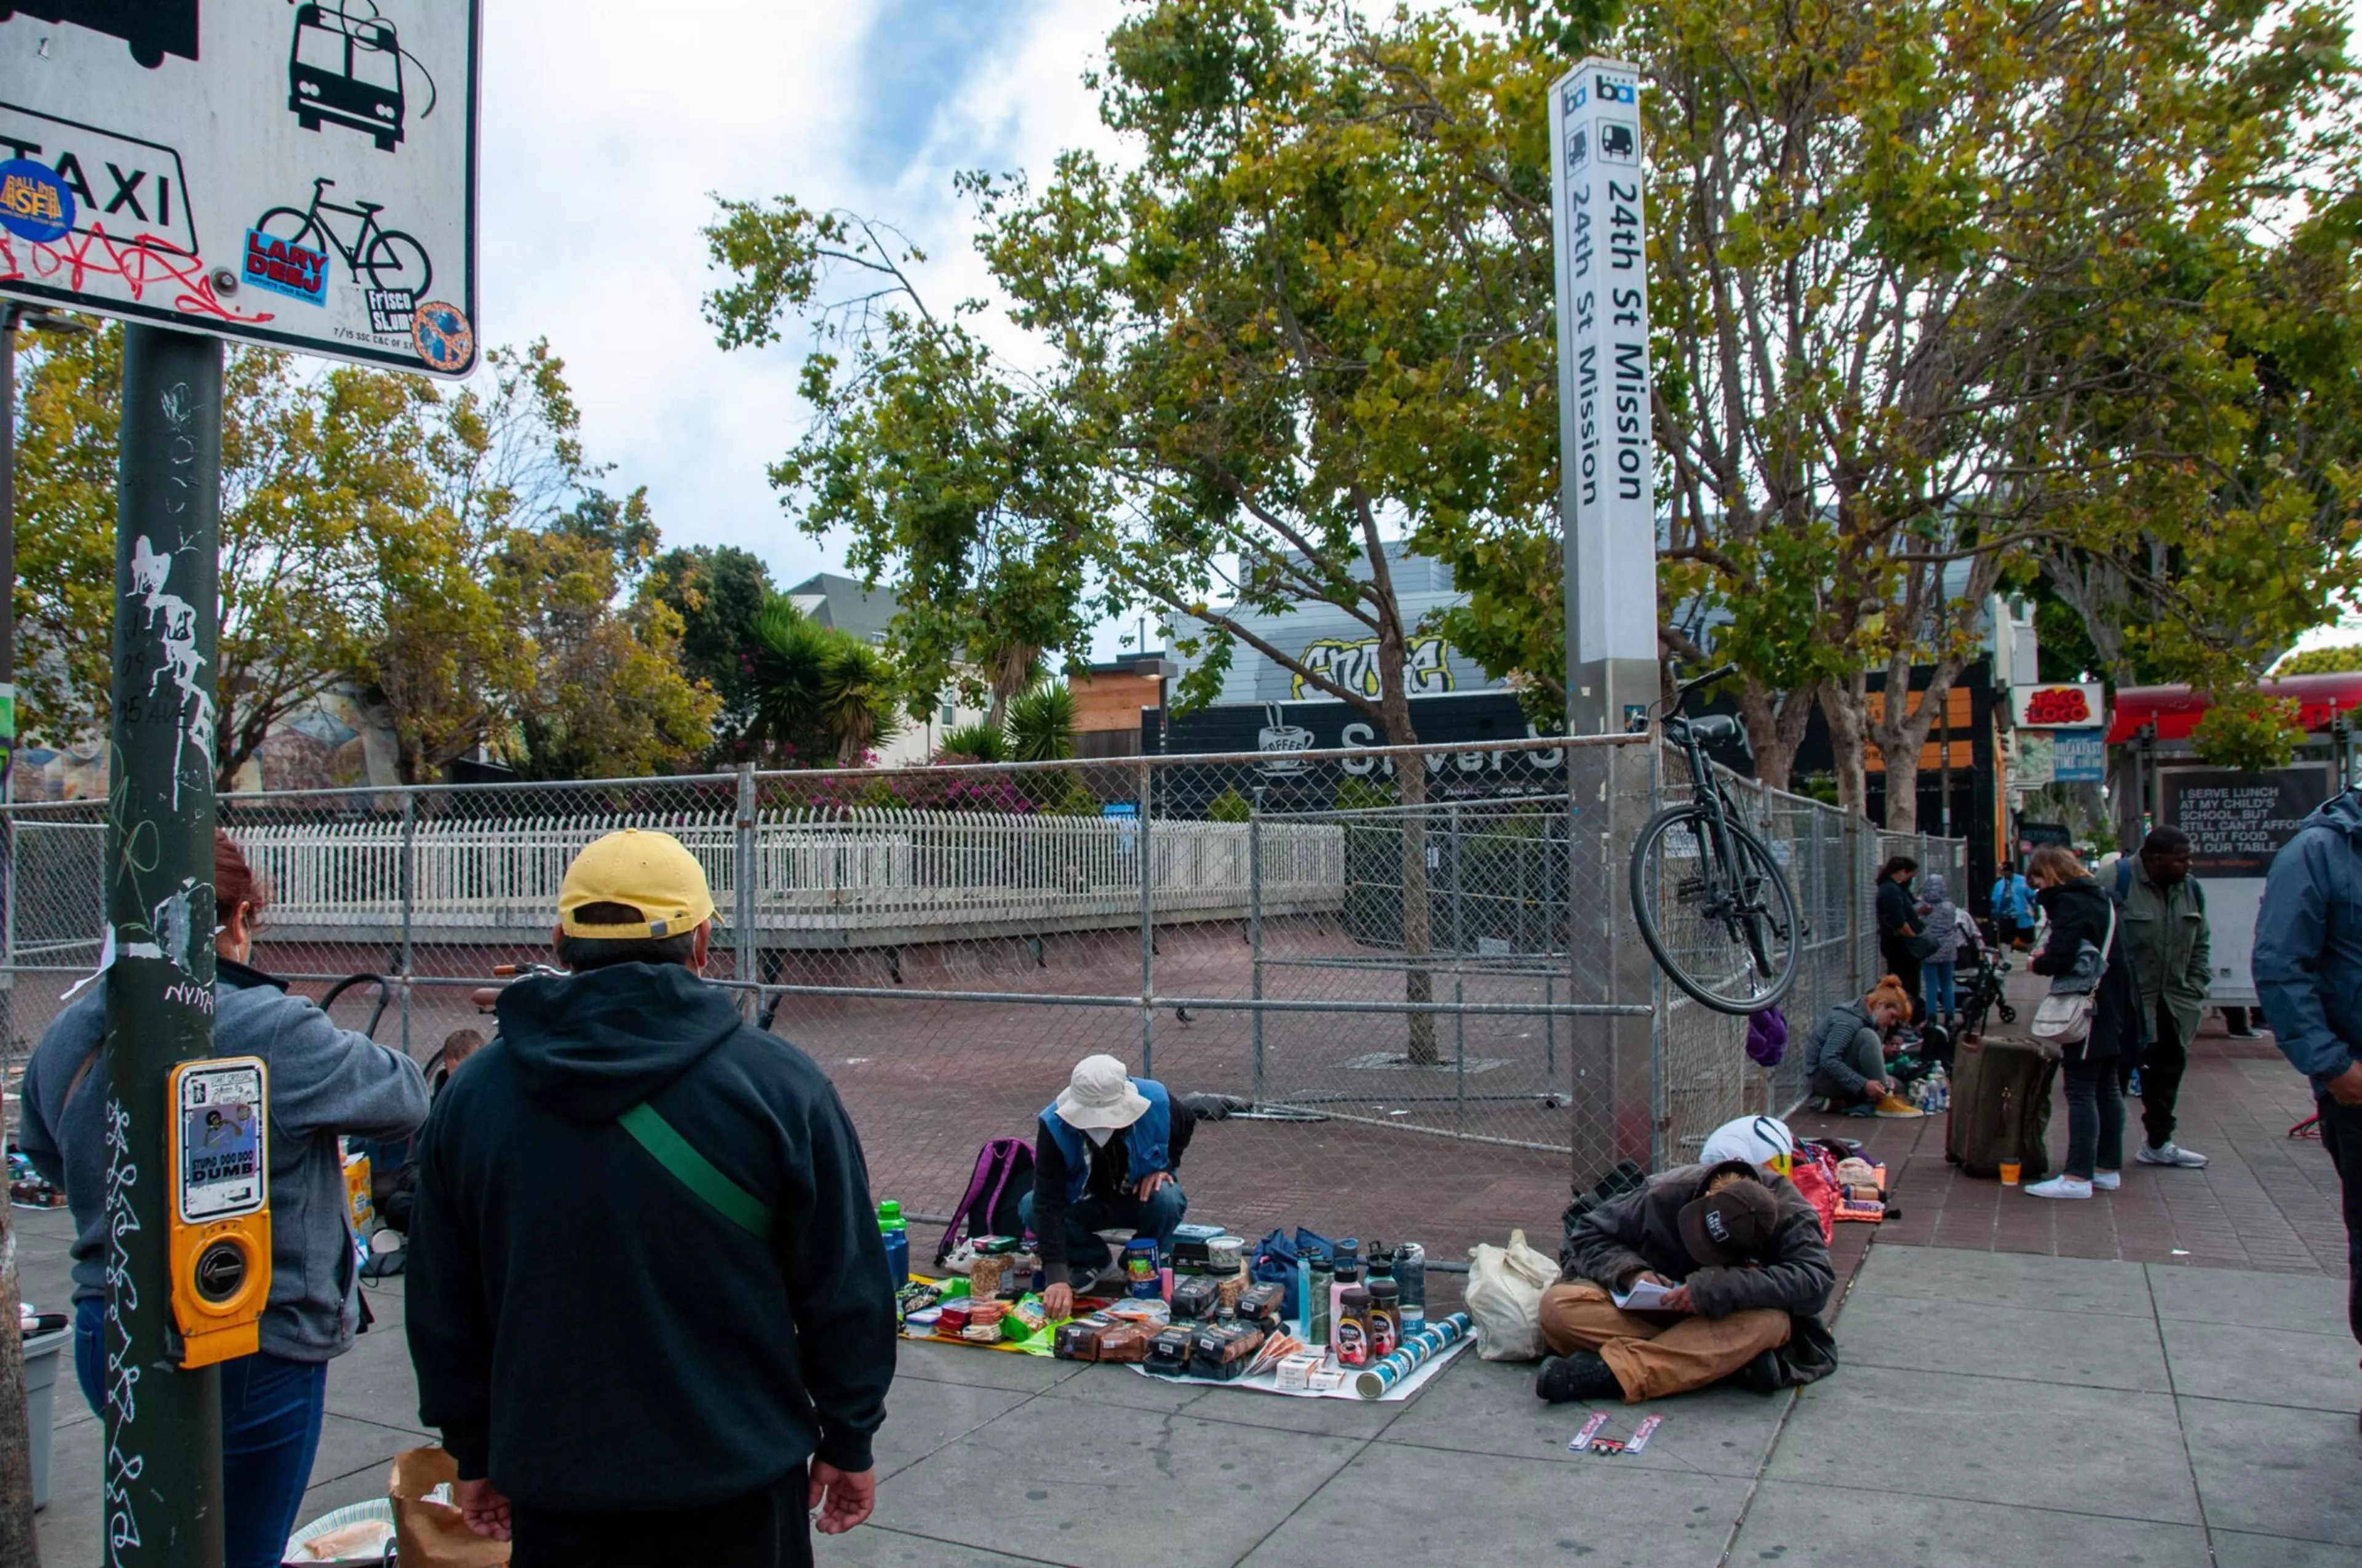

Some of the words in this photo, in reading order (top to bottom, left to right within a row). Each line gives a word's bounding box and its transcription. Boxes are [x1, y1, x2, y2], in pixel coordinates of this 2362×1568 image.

[1573, 183, 1594, 278] 24th
[1608, 180, 1642, 269] 24th
[249, 232, 329, 273] LARY
[1577, 290, 1594, 334] St
[1613, 288, 1642, 327] St
[1579, 344, 1599, 506] Mission
[1614, 343, 1648, 499] Mission
[2032, 689, 2085, 707] TACO
[2027, 706, 2087, 723] LOCO
[2180, 789, 2184, 798] I
[2187, 788, 2230, 798] SERVE
[2233, 787, 2280, 797] LUNCH
[2180, 800, 2195, 810] AT
[2199, 799, 2219, 809] MY
[2222, 798, 2276, 808] CHILD'S
[2242, 809, 2269, 819] BUT
[2181, 821, 2214, 831] STILL
[2218, 820, 2259, 830] CAN'T
[2202, 832, 2227, 842] PUT
[2231, 831, 2268, 841] FOOD
[2204, 842, 2233, 853] OUR
[193, 1163, 253, 1182] DUMB
